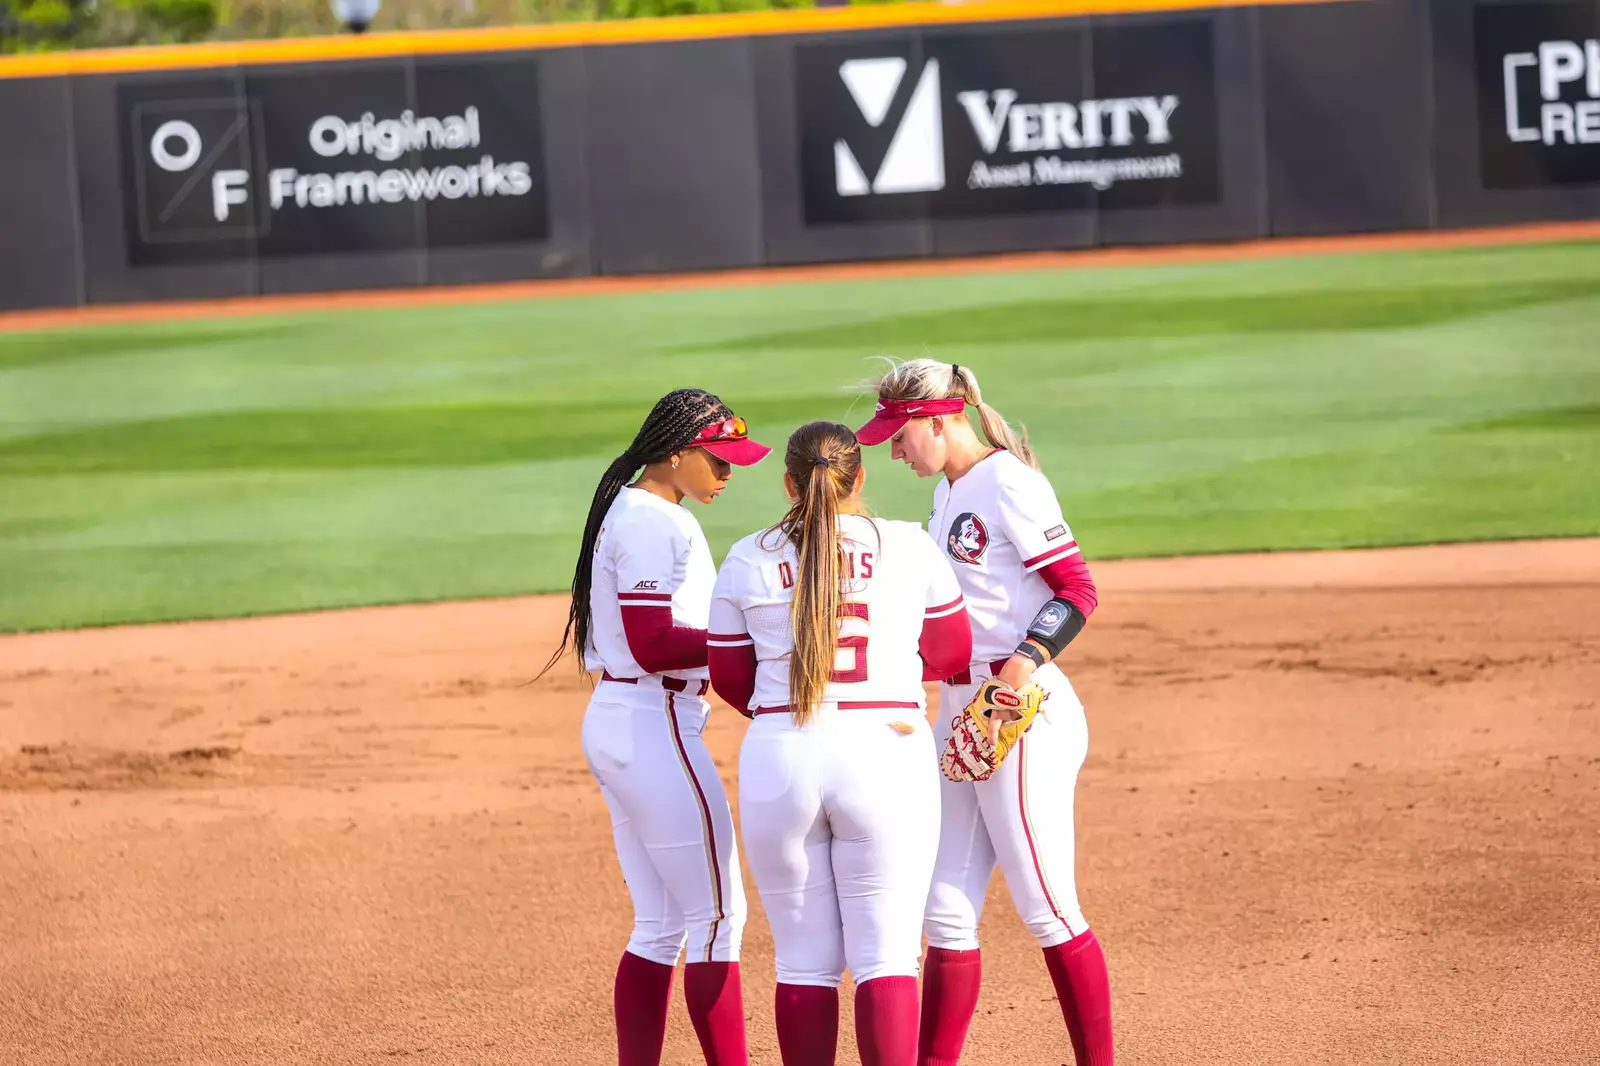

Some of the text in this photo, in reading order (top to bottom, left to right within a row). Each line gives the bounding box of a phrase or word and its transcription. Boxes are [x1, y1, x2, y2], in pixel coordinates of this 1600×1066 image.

[150, 119, 202, 172] O
[309, 105, 481, 161] Original
[957, 88, 1180, 154] VERITY
[212, 169, 250, 222] F
[268, 154, 532, 210] Frameworks
[966, 152, 1183, 191] Asset Management
[633, 580, 659, 590] ACC
